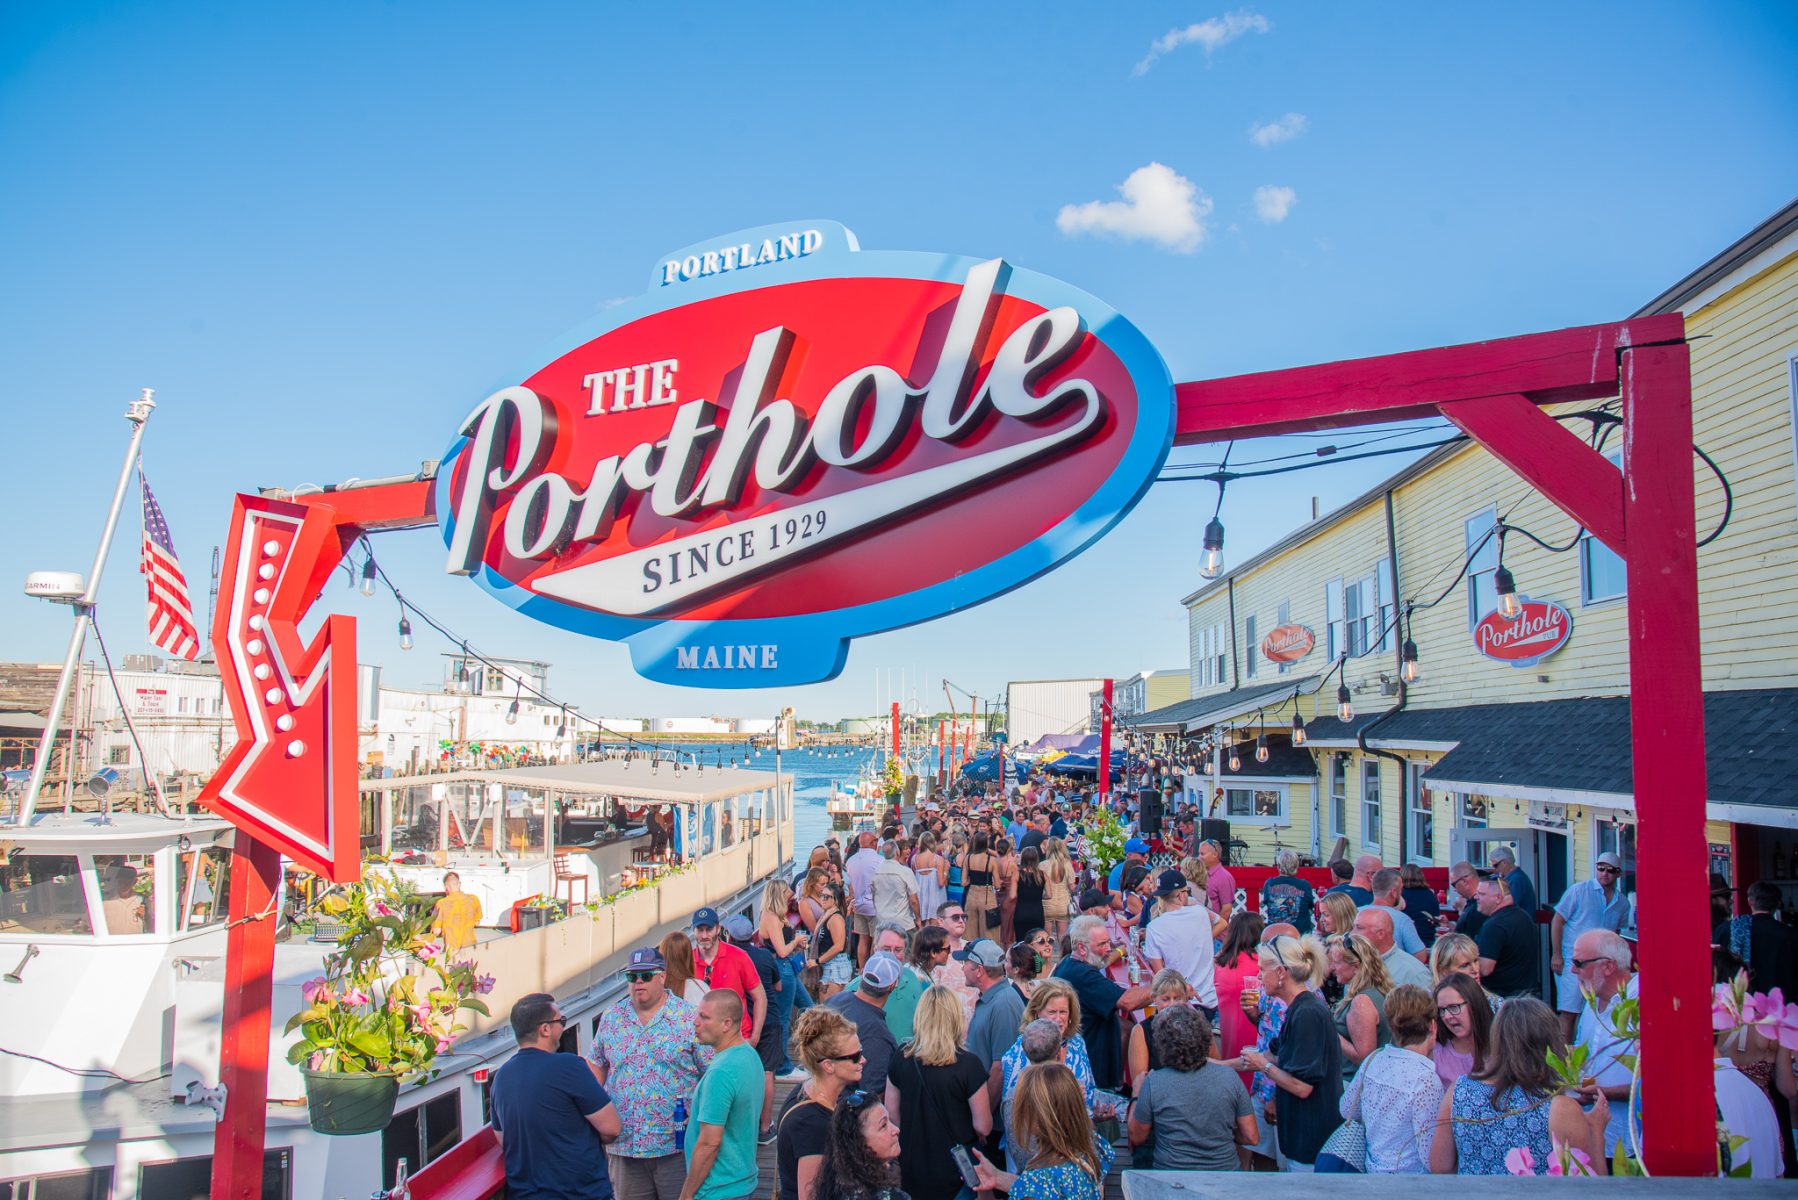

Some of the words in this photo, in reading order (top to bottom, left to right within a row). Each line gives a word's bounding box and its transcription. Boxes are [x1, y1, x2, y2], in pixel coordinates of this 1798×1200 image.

[662, 229, 823, 285] PORTLAND
[583, 359, 679, 417] THE
[446, 257, 1099, 576] Porthole
[642, 531, 756, 593] SINCE
[768, 510, 828, 551] 1929
[1262, 625, 1311, 657] Porthole
[1479, 603, 1564, 655] Porthole
[676, 644, 778, 671] MAINE
